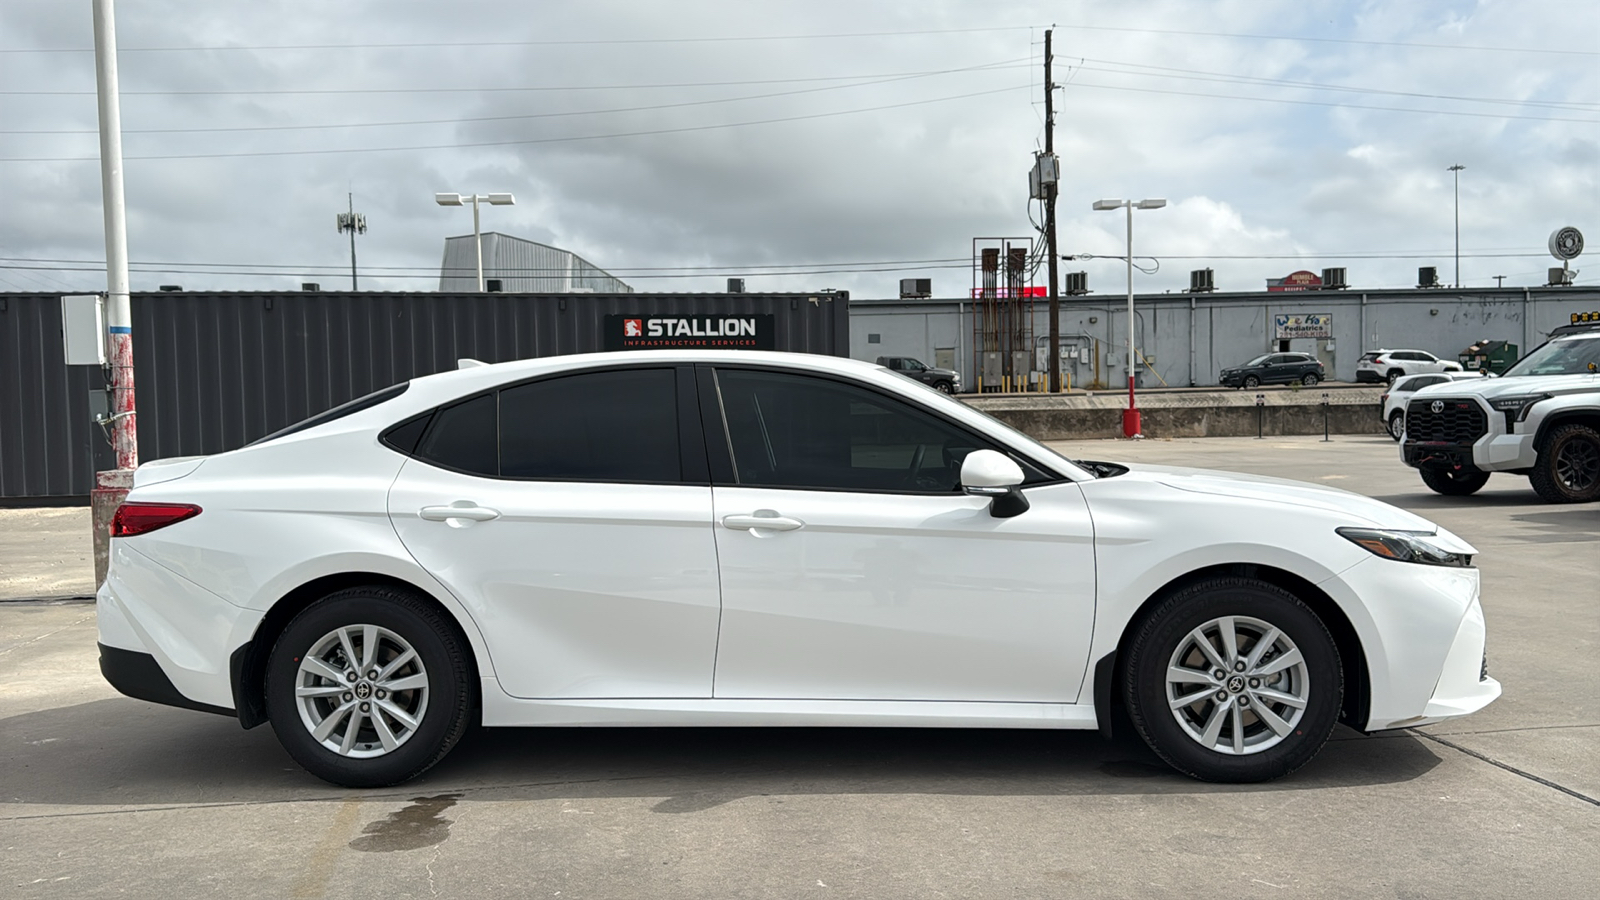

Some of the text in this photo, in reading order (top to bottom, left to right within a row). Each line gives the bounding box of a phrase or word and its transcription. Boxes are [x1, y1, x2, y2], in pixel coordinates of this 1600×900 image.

[647, 318, 756, 337] STALLION
[1277, 314, 1330, 326] Wee Kare
